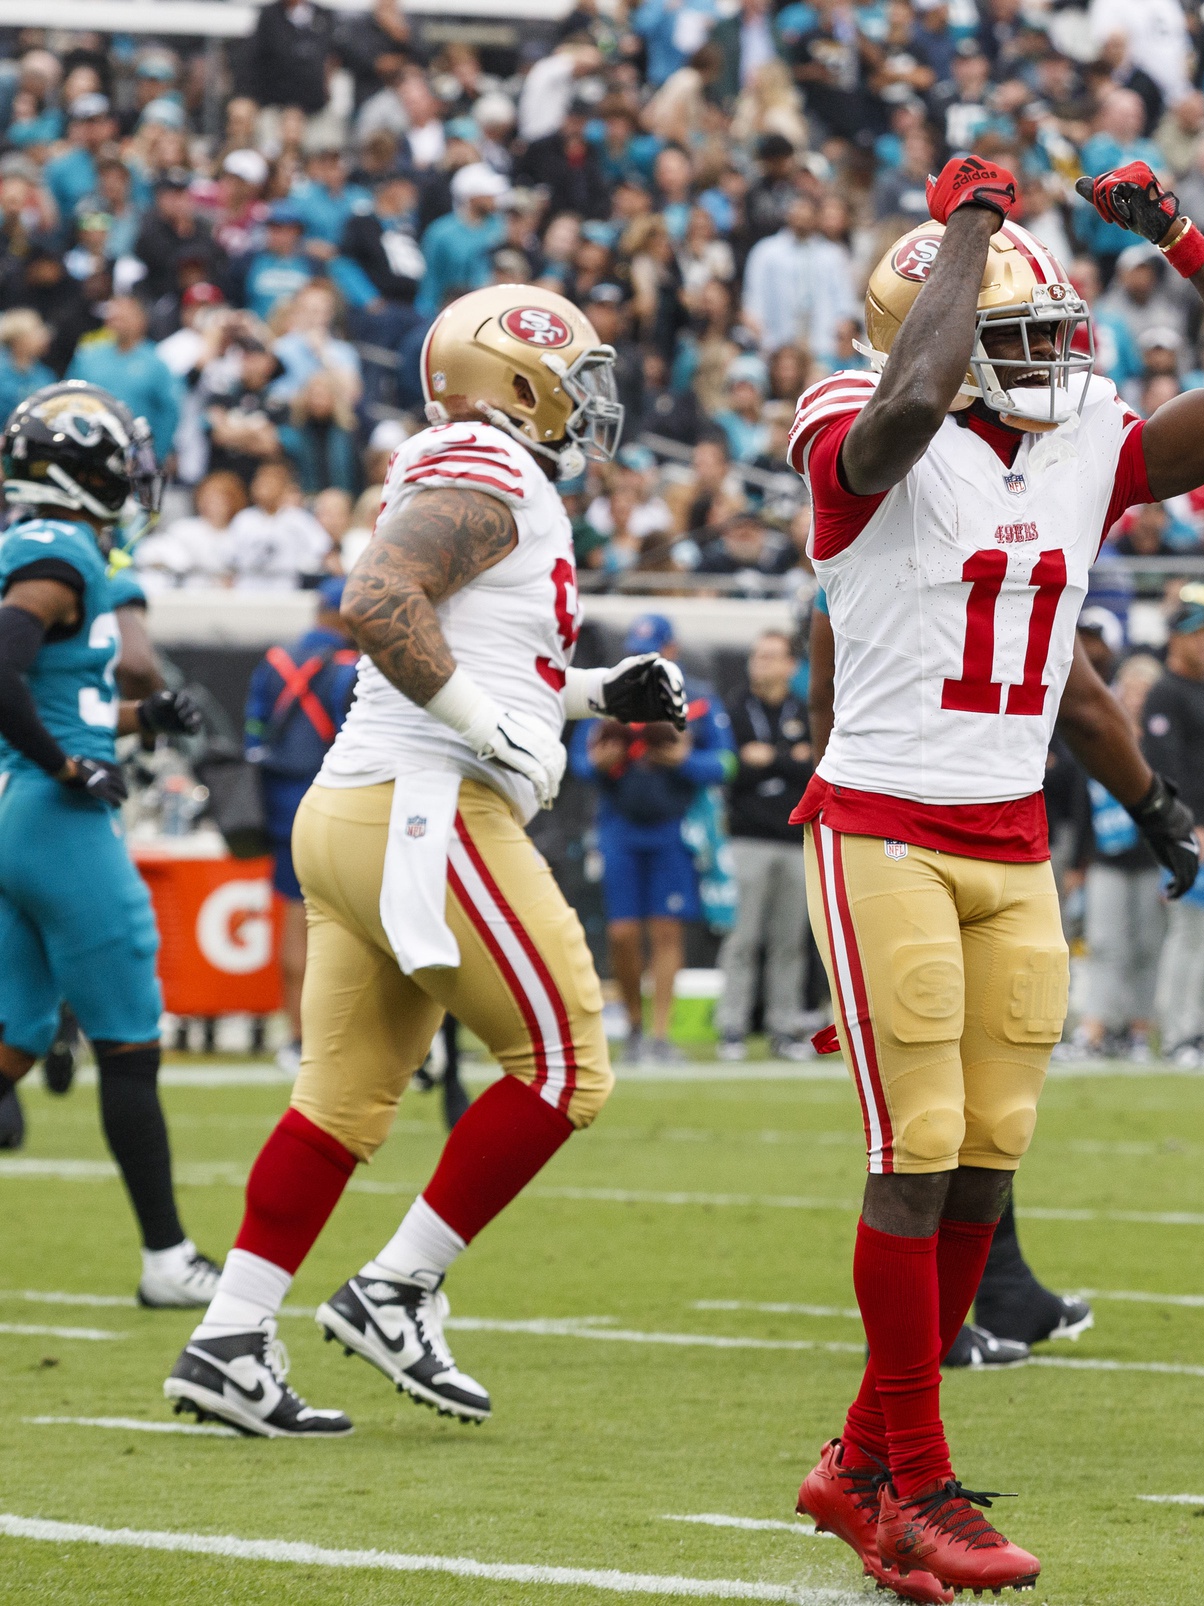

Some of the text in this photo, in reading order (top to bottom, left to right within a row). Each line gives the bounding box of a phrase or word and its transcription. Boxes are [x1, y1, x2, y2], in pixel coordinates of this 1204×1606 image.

[952, 170, 997, 190] adidas
[519, 309, 563, 344] SF
[1007, 481, 1026, 493] NFL
[994, 521, 1039, 544] 49ERS
[941, 548, 1067, 715] 11
[887, 844, 904, 856] NFL
[195, 879, 273, 975] G
